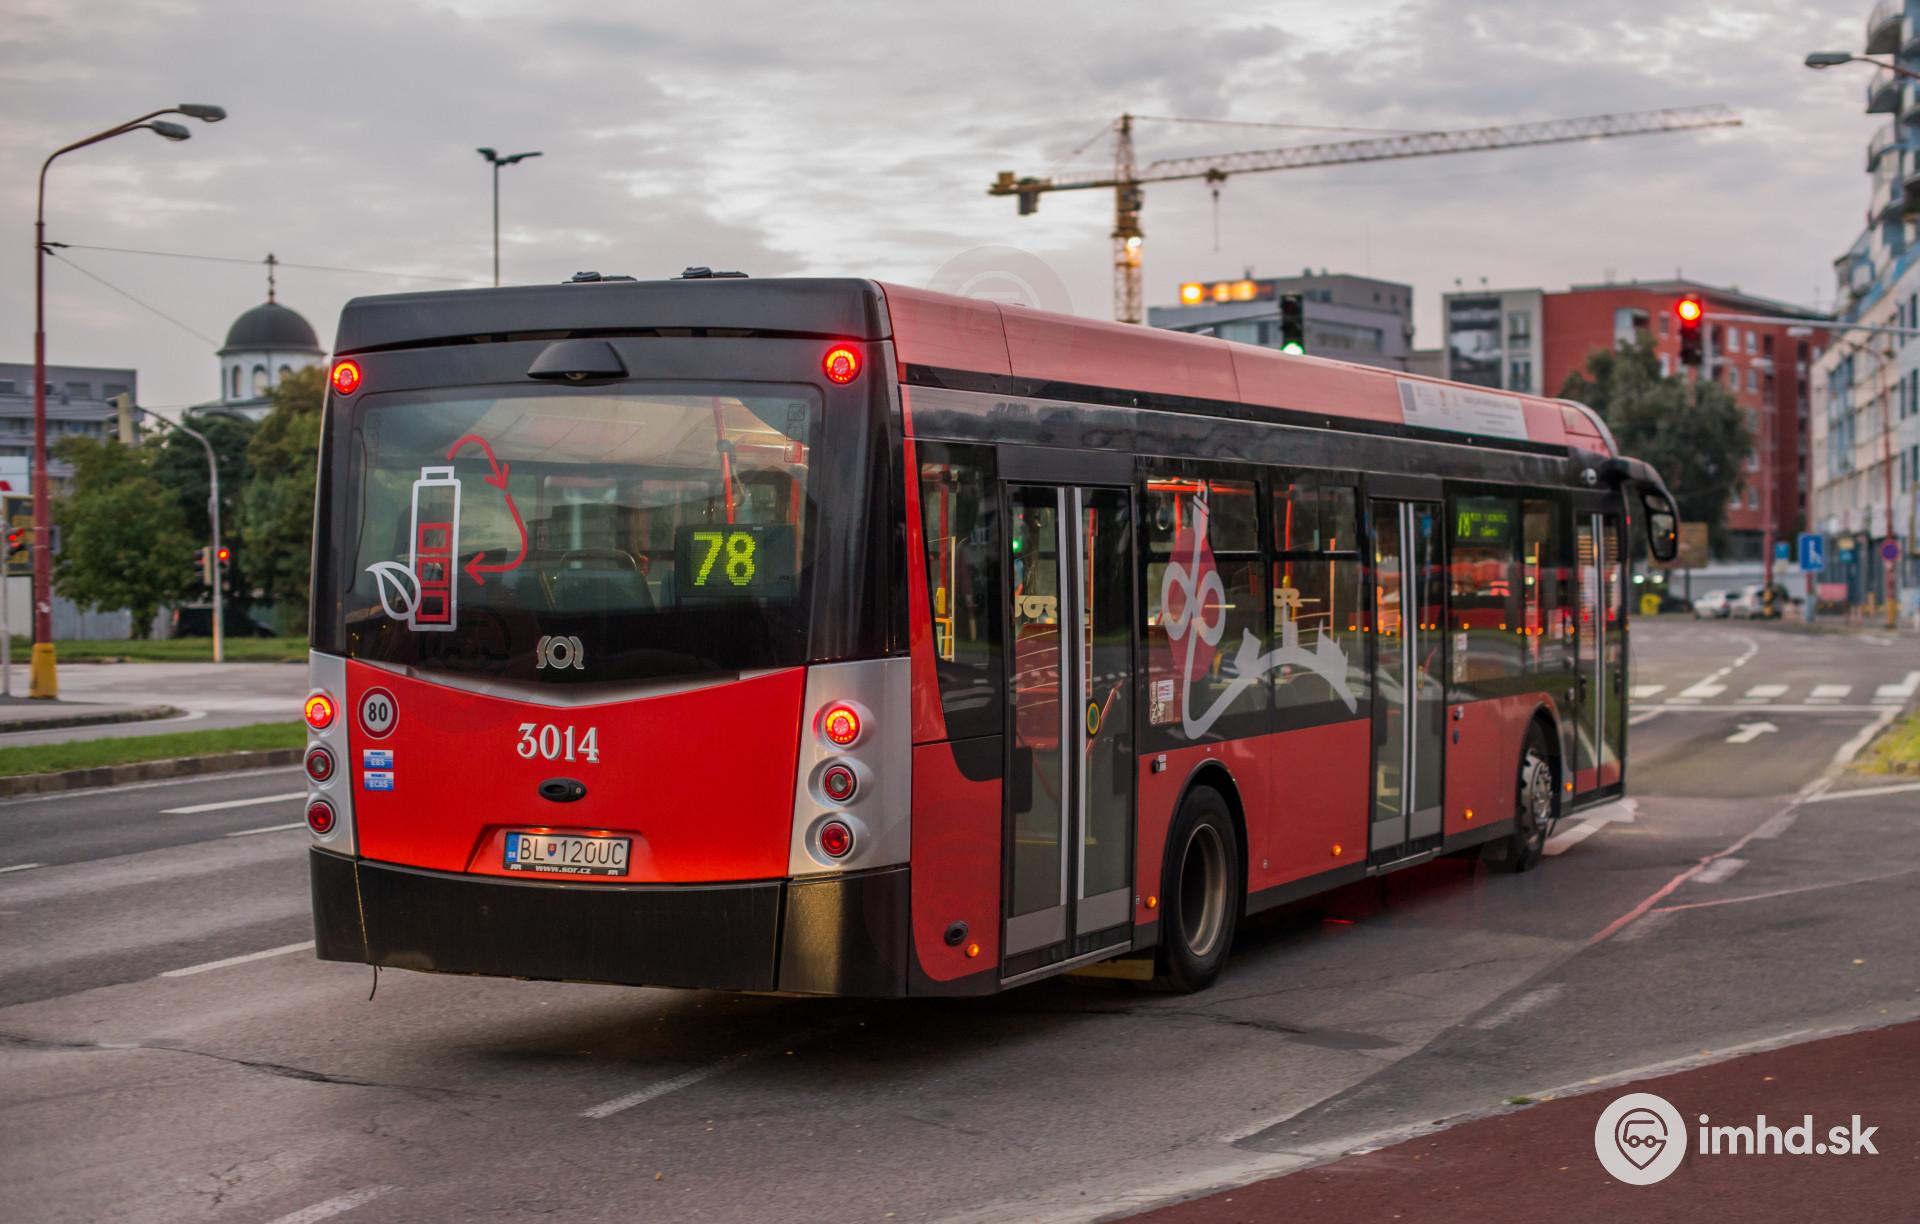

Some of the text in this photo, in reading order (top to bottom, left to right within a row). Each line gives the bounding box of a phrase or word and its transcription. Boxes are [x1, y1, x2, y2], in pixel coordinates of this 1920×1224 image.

[693, 531, 756, 586] 78
[368, 702, 388, 722] 80
[516, 722, 600, 763] 3014
[519, 837, 624, 865] BL 120UC
[535, 864, 592, 875] www.sor.cz
